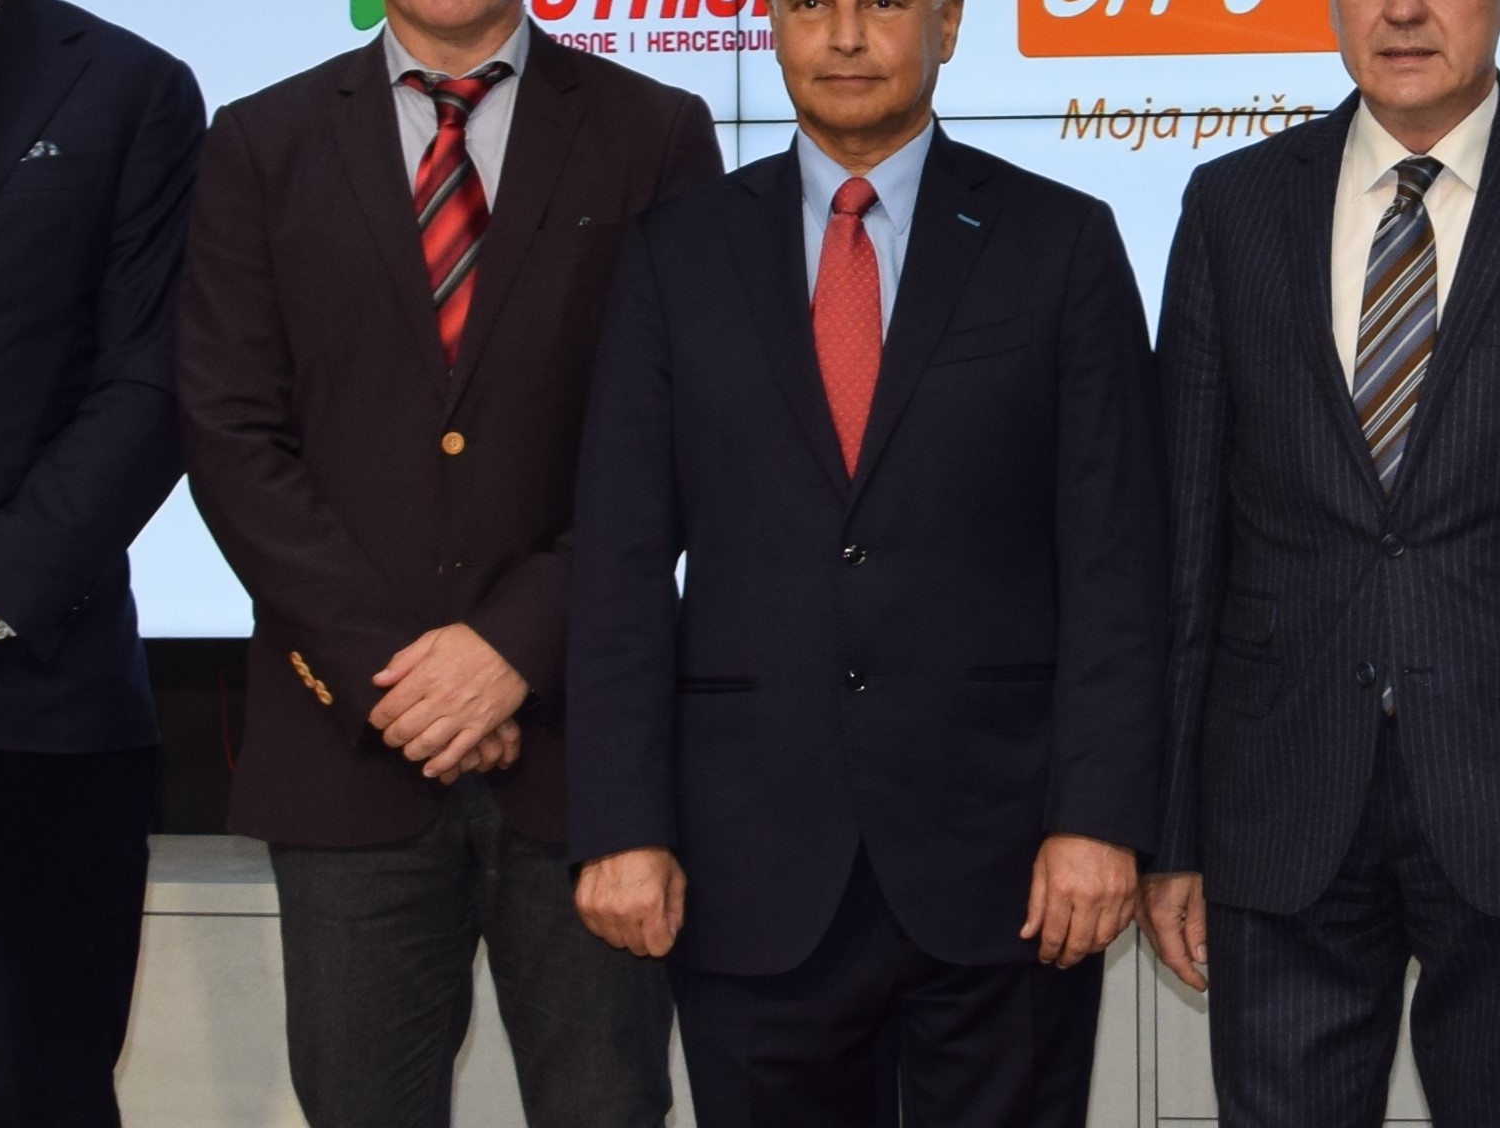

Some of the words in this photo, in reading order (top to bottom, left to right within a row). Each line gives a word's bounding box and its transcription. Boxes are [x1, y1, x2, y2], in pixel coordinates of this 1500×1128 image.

[629, 32, 636, 53] I
[647, 30, 776, 53] HERCEGOVI
[1060, 97, 1182, 151] Moja
